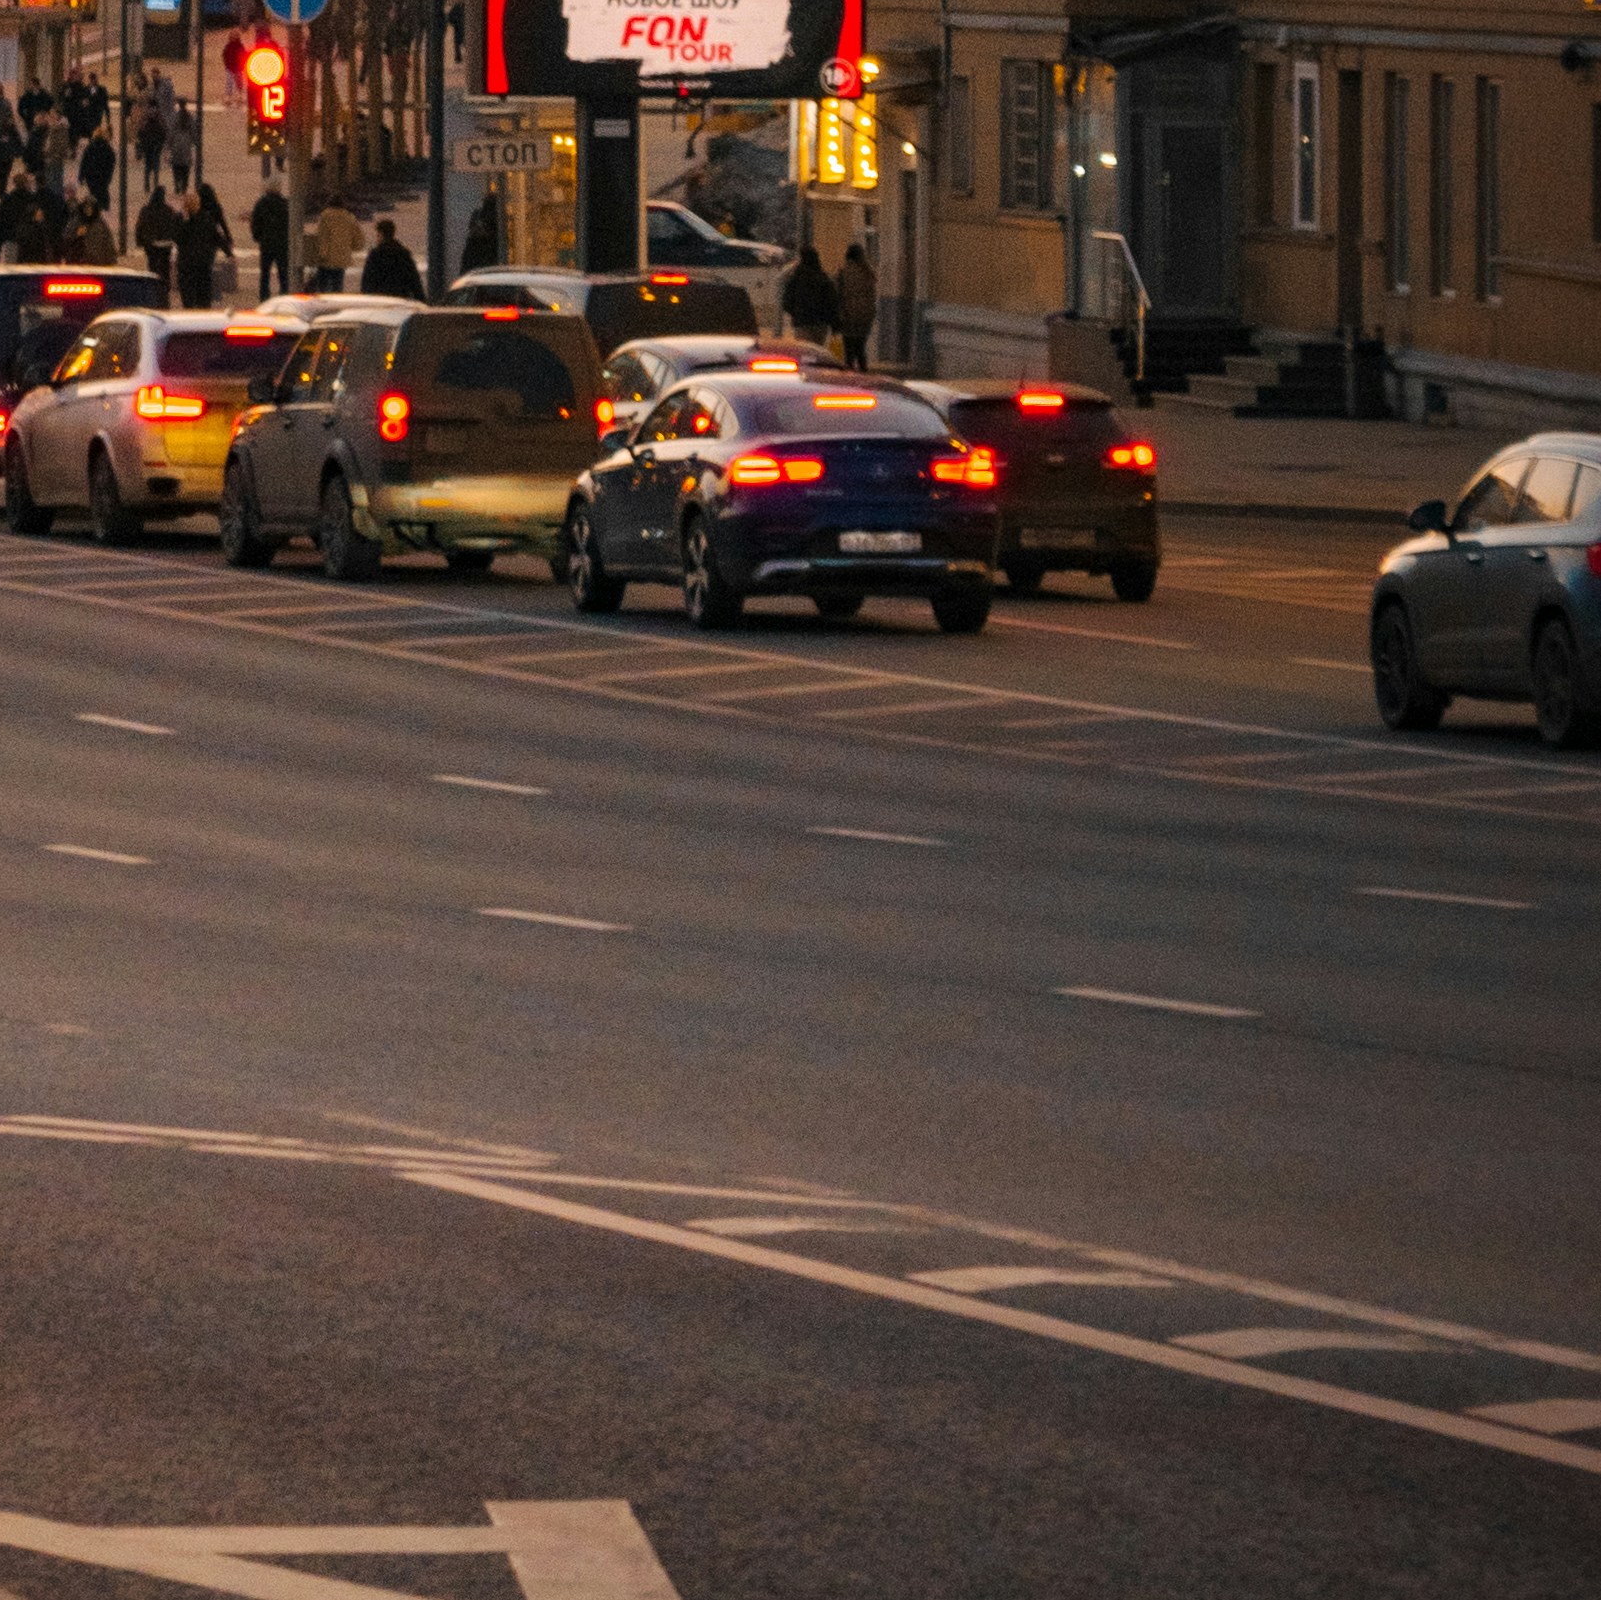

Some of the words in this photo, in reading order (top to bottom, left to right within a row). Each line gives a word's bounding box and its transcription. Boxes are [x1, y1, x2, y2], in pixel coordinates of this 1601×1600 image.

[620, 15, 708, 48] FON
[666, 43, 734, 63] TOUR
[262, 85, 285, 119] 12
[467, 143, 539, 167] СТОП
